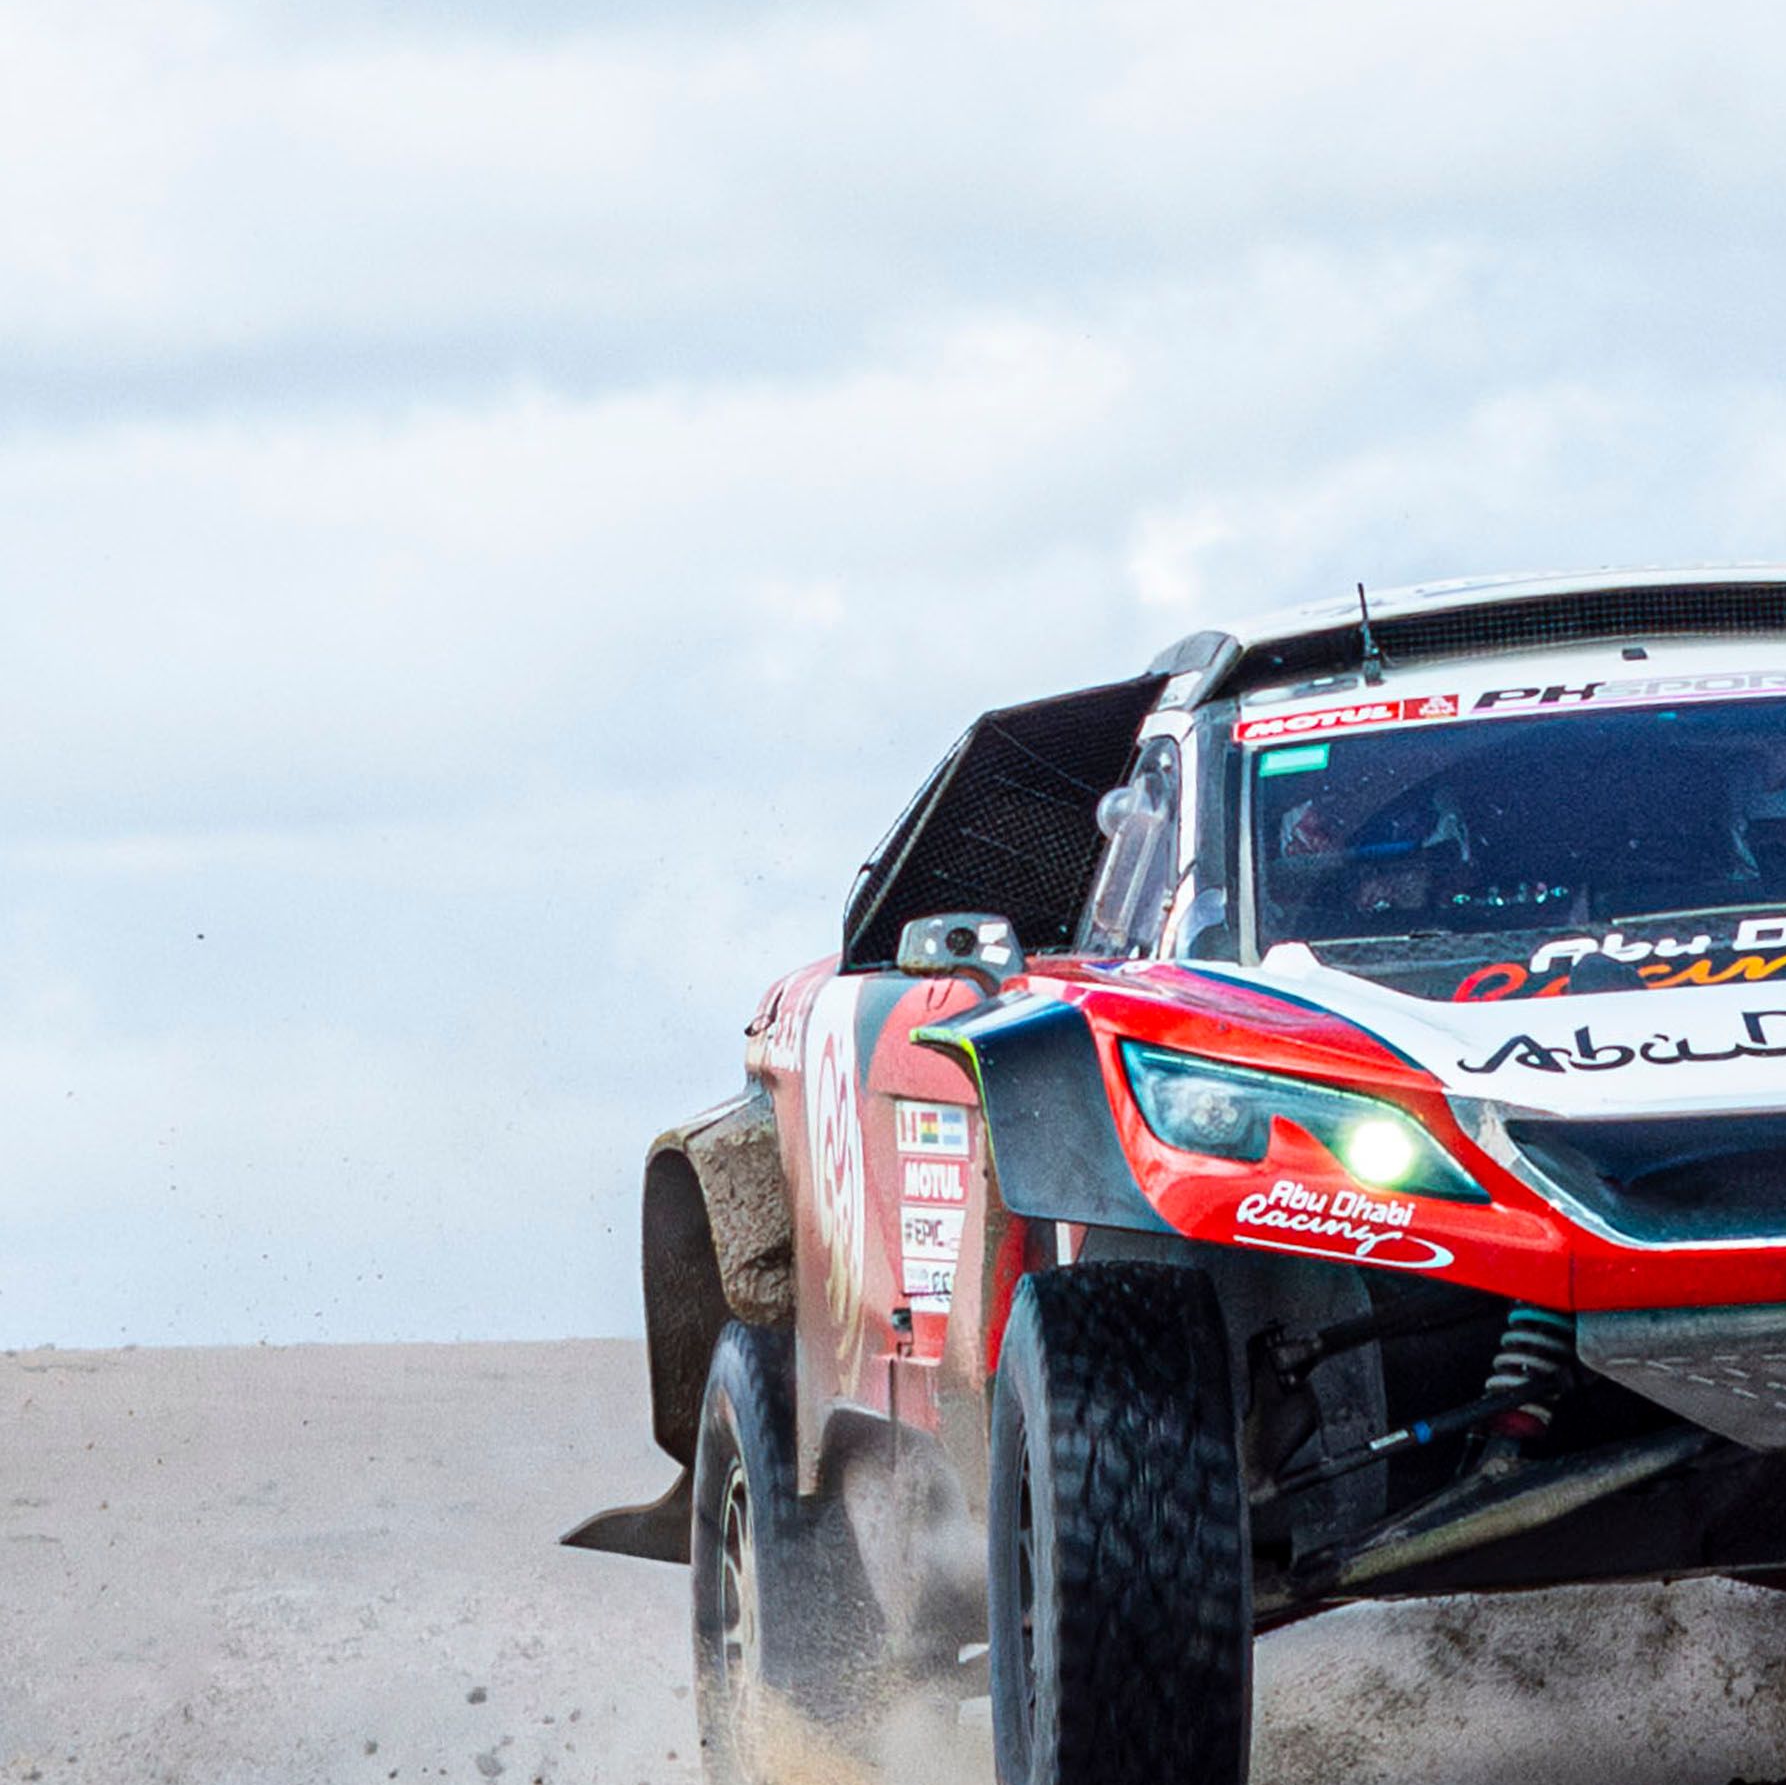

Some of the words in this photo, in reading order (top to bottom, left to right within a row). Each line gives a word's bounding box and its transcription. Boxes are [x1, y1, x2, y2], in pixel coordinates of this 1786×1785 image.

[1244, 703, 1394, 739] MOTUL
[1529, 933, 1712, 973] Abu
[904, 1161, 964, 1200] MOTUL
[1268, 1180, 1328, 1213] Abu
[1330, 1190, 1416, 1227] Dhabi
[1236, 1193, 1404, 1256] Racing
